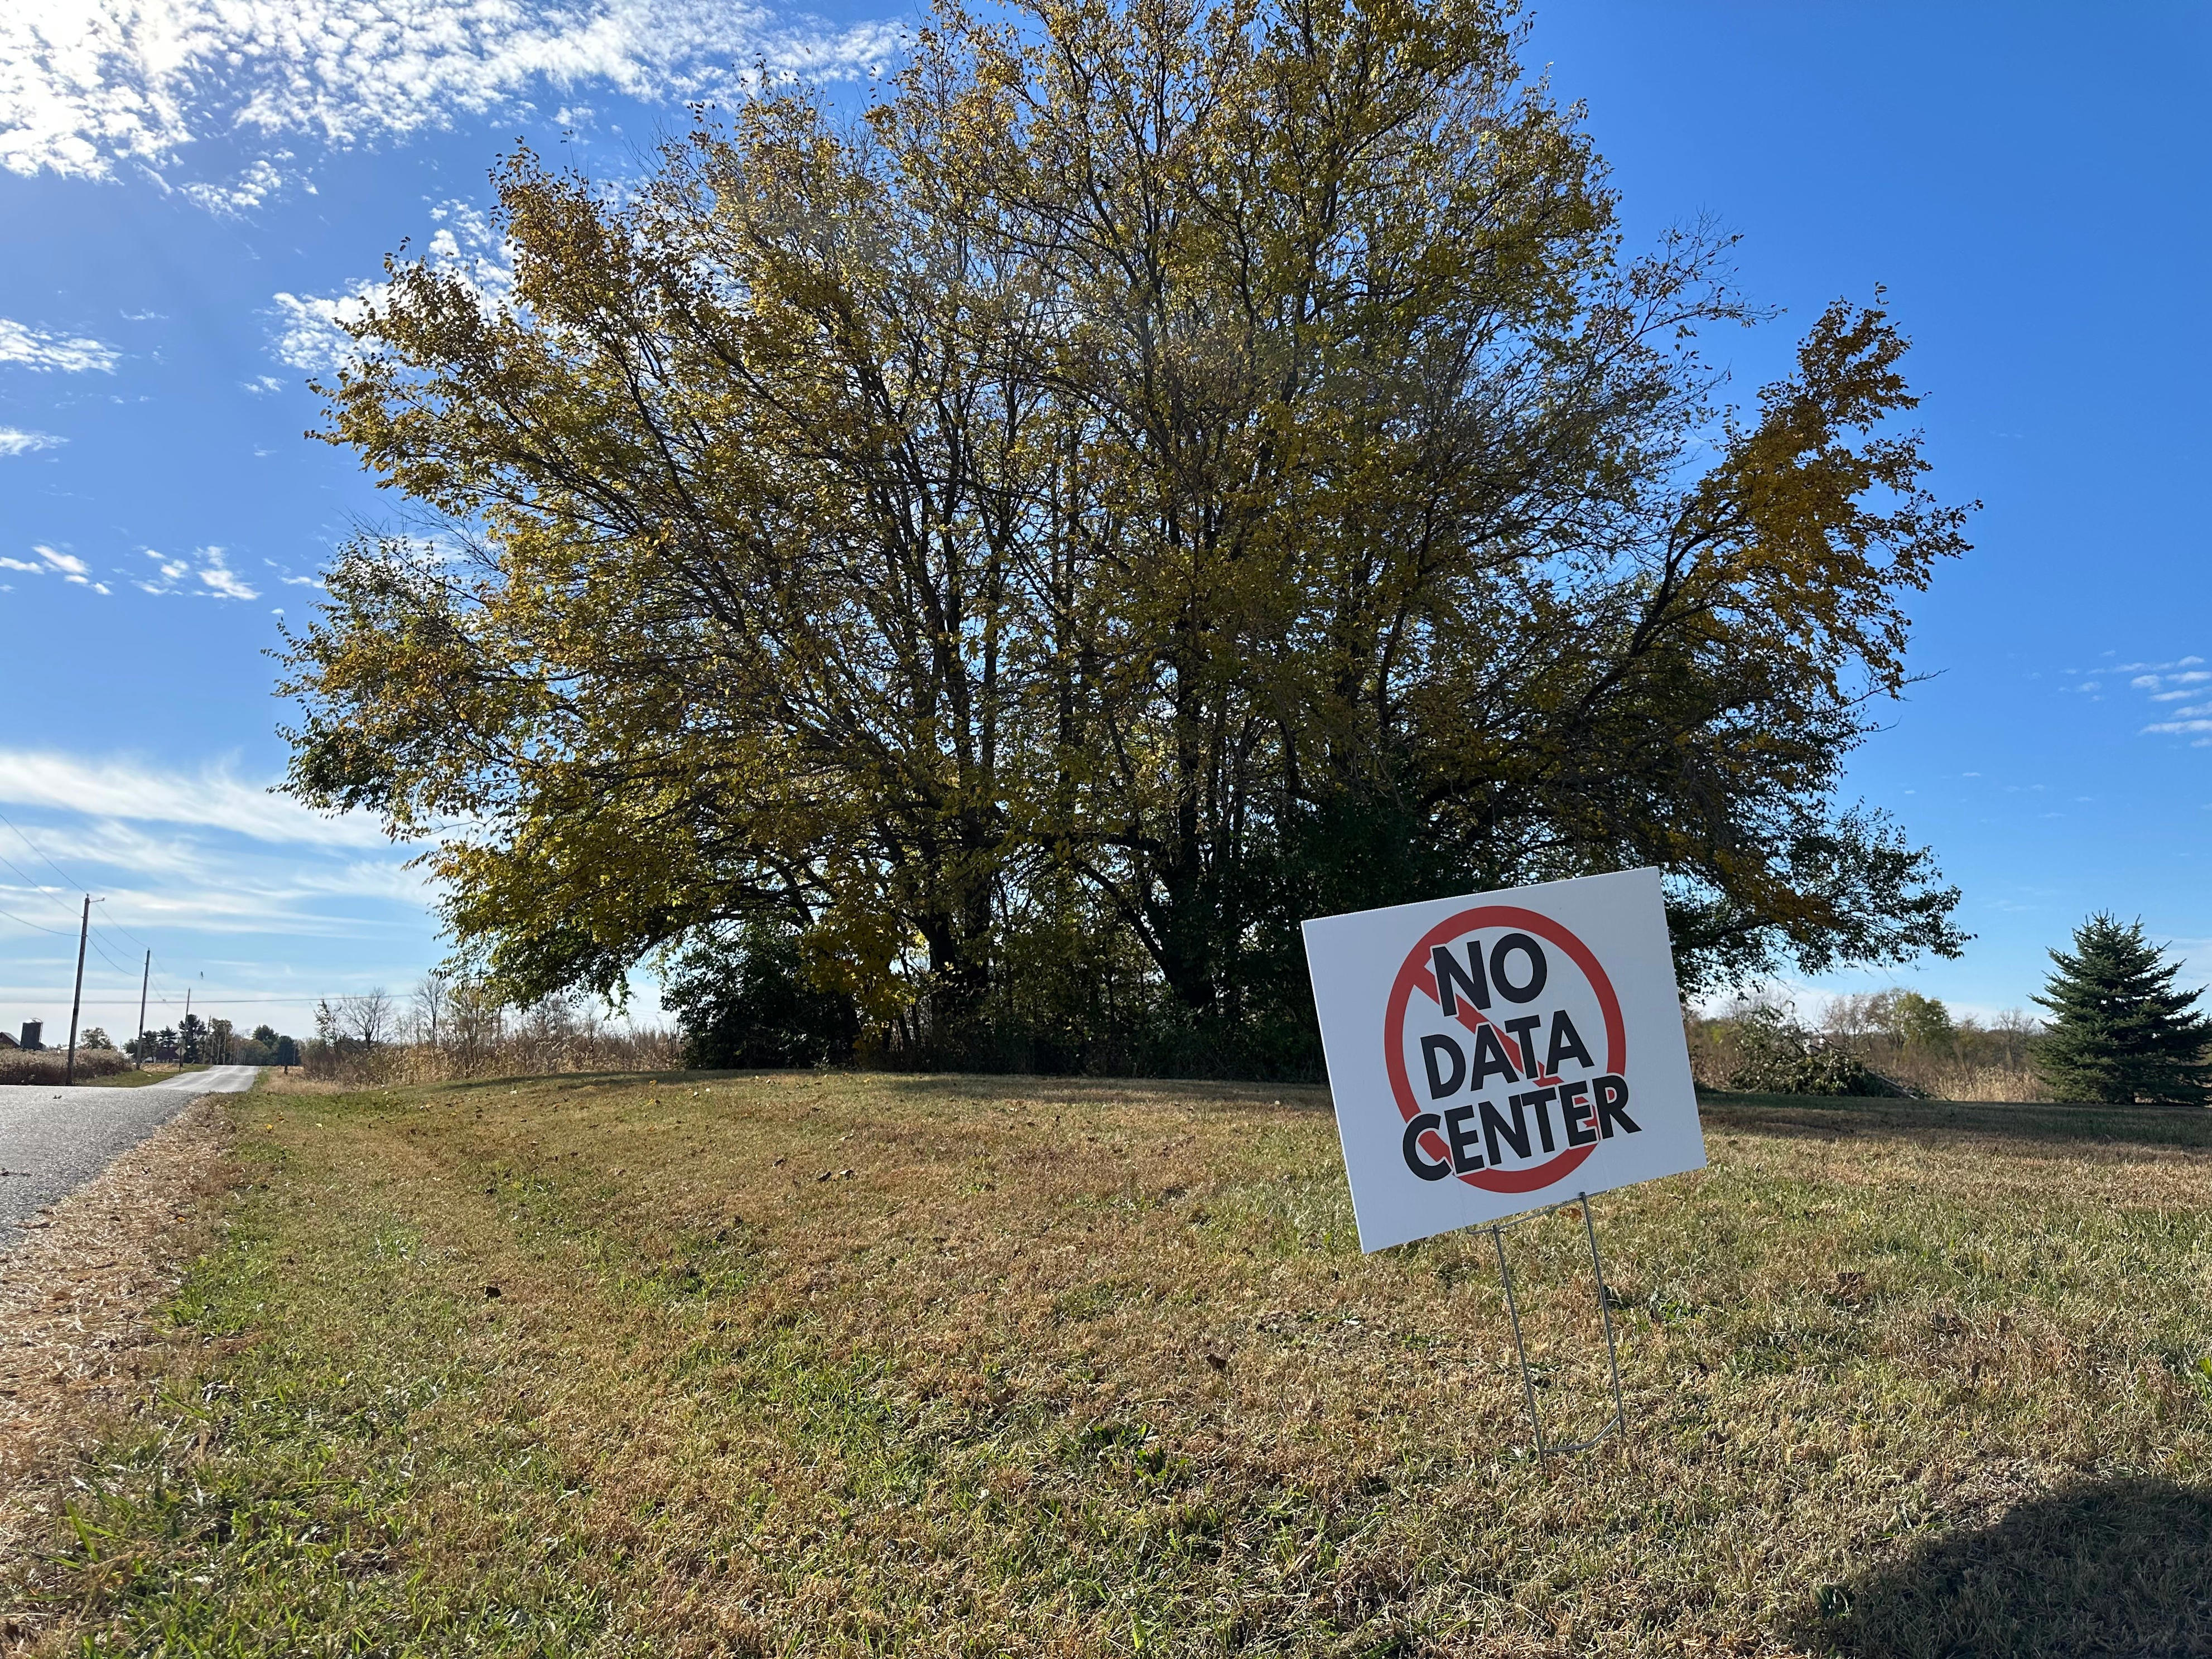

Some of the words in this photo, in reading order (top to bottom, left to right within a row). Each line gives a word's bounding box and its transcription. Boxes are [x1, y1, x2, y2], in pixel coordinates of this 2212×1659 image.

[1432, 933, 1548, 1017] NO
[1420, 1010, 1595, 1100] DATA
[1403, 1075, 1642, 1181] CENTER
